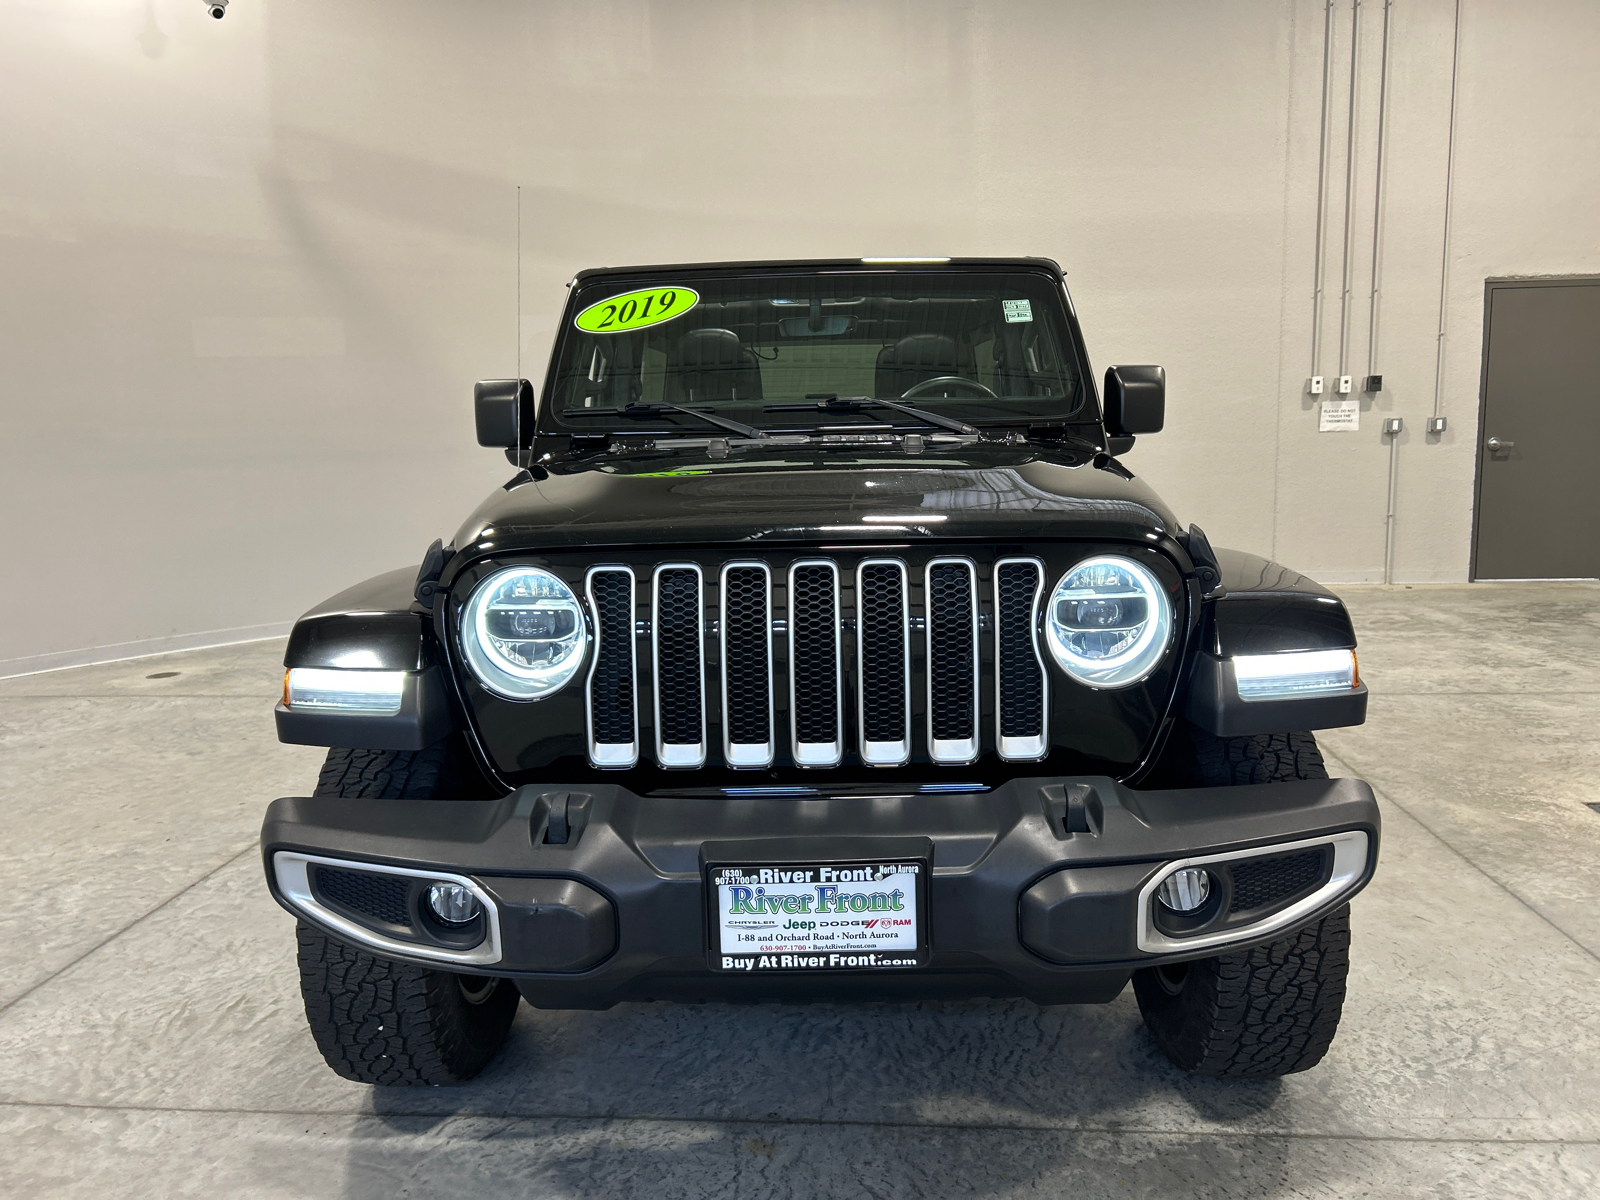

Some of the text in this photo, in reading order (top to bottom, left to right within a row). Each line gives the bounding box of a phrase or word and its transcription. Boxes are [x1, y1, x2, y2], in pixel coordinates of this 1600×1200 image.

[597, 290, 676, 329] 2019
[722, 869, 743, 878] (630)
[759, 866, 873, 884] River Front
[879, 864, 919, 874] North Aurora
[714, 876, 750, 885] 907-1700
[728, 884, 905, 915] River Front
[782, 918, 817, 931] Jeep
[737, 930, 899, 942] I-88 and Orchard Road North Aurora
[759, 942, 877, 952] 630-907-1700 BuyAtRiverFront.com
[721, 956, 755, 971] Buy
[758, 955, 778, 968] At
[780, 954, 827, 968] River
